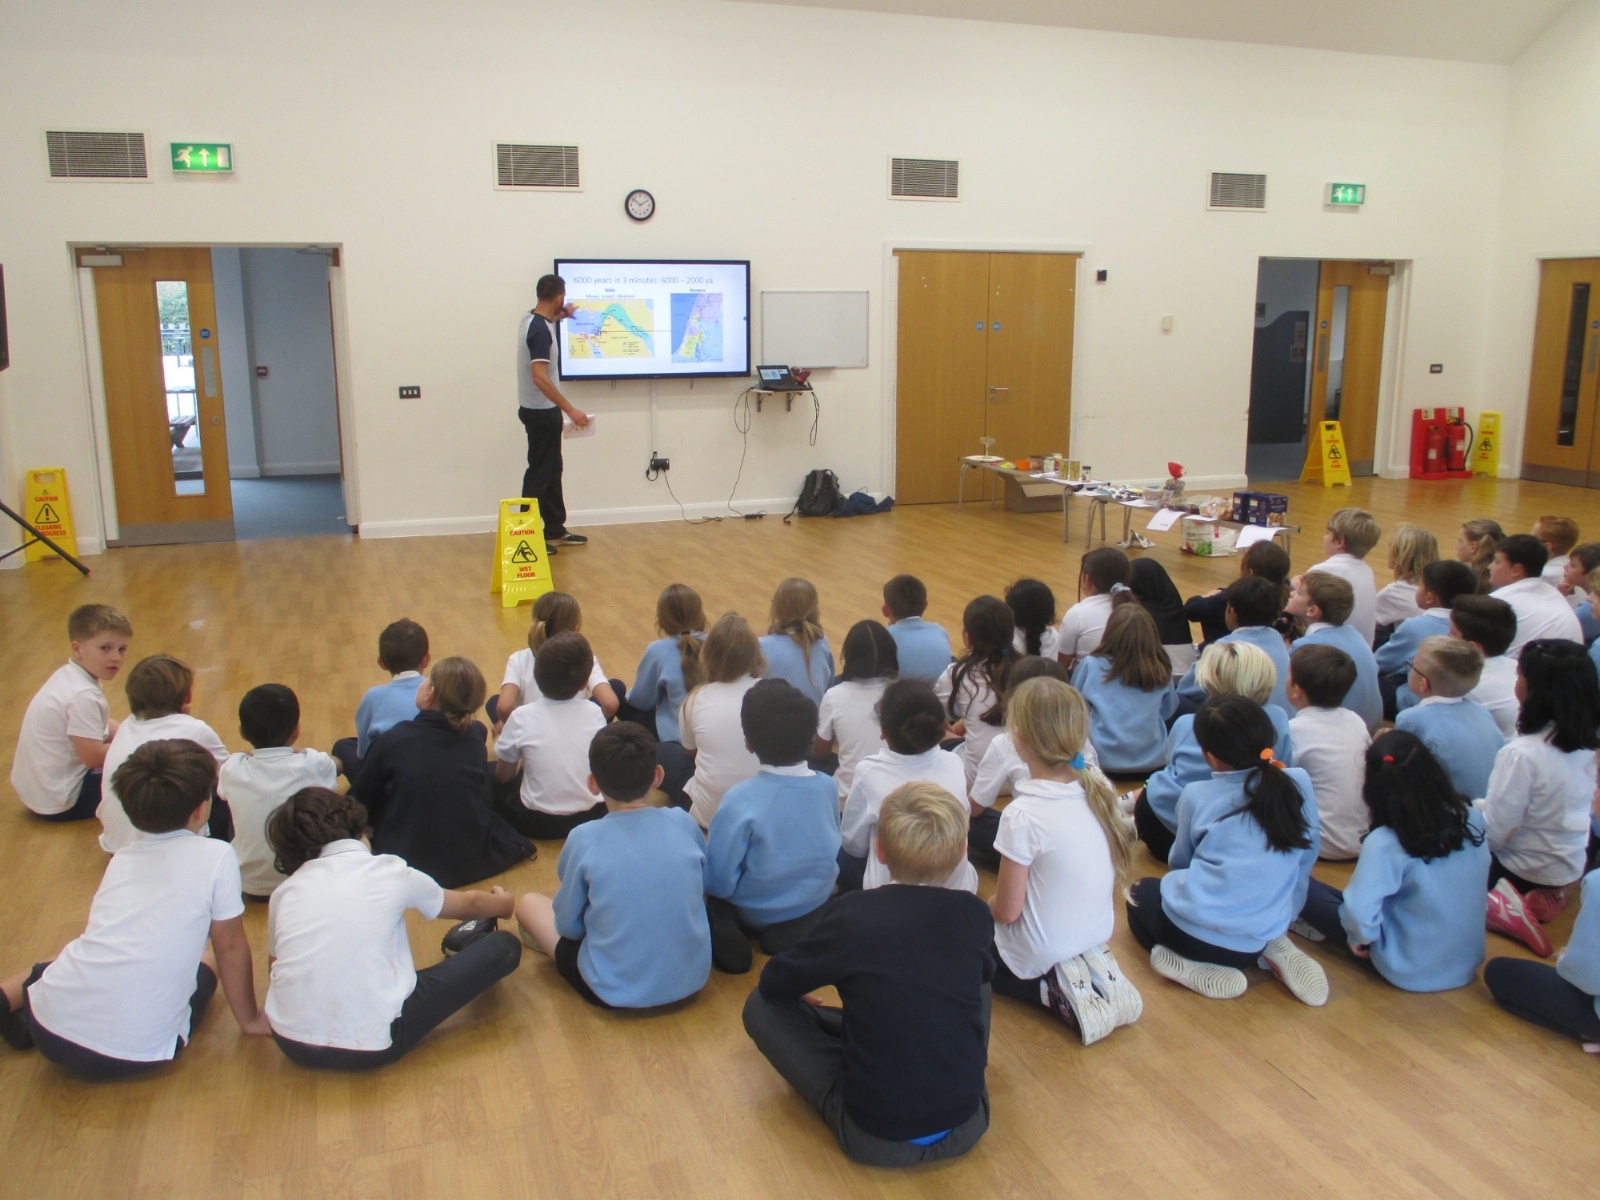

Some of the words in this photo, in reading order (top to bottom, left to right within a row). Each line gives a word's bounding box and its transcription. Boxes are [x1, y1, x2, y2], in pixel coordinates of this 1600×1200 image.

[573, 276, 592, 284] 6000
[593, 277, 613, 285] years
[613, 276, 621, 284] in
[622, 276, 627, 284] 3
[628, 276, 660, 284] minutes:
[660, 276, 679, 284] 6000
[686, 276, 704, 284] 2000
